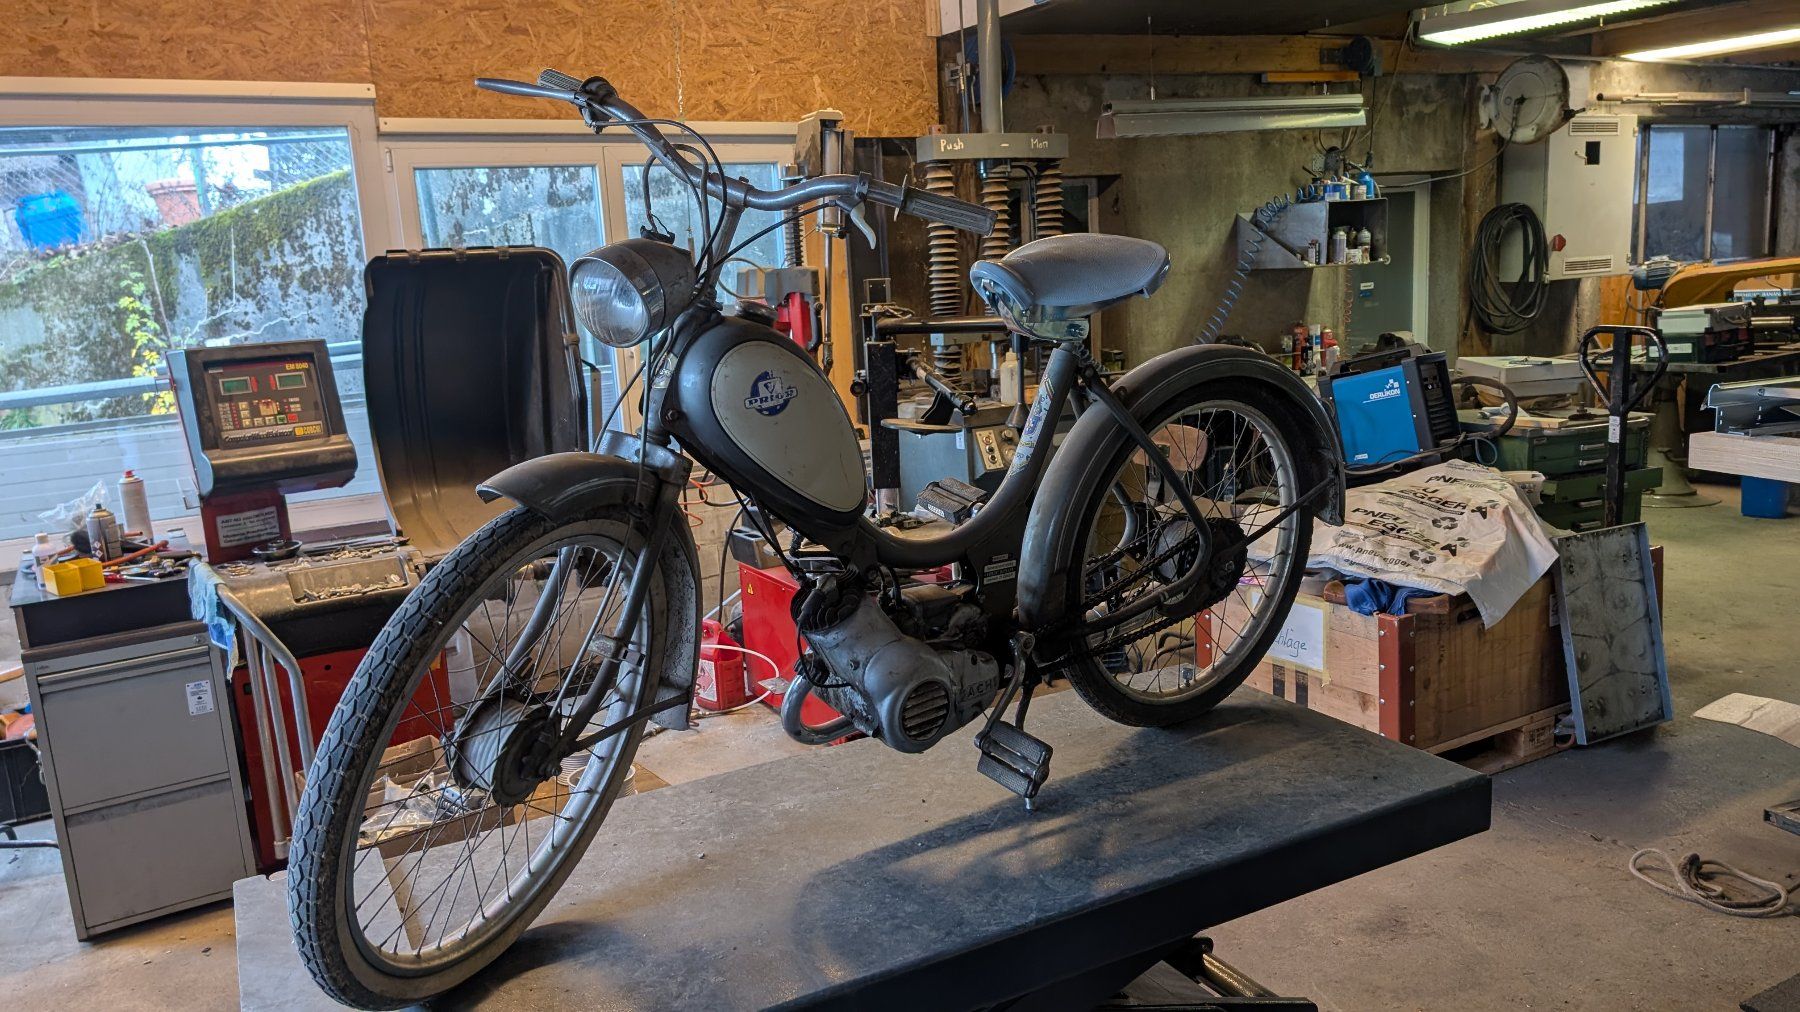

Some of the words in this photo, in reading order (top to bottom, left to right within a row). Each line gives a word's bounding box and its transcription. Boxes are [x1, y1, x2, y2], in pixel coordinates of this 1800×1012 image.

[940, 138, 964, 152] Push
[748, 389, 795, 407] PRIOR
[1369, 388, 1401, 400] OERLIKON
